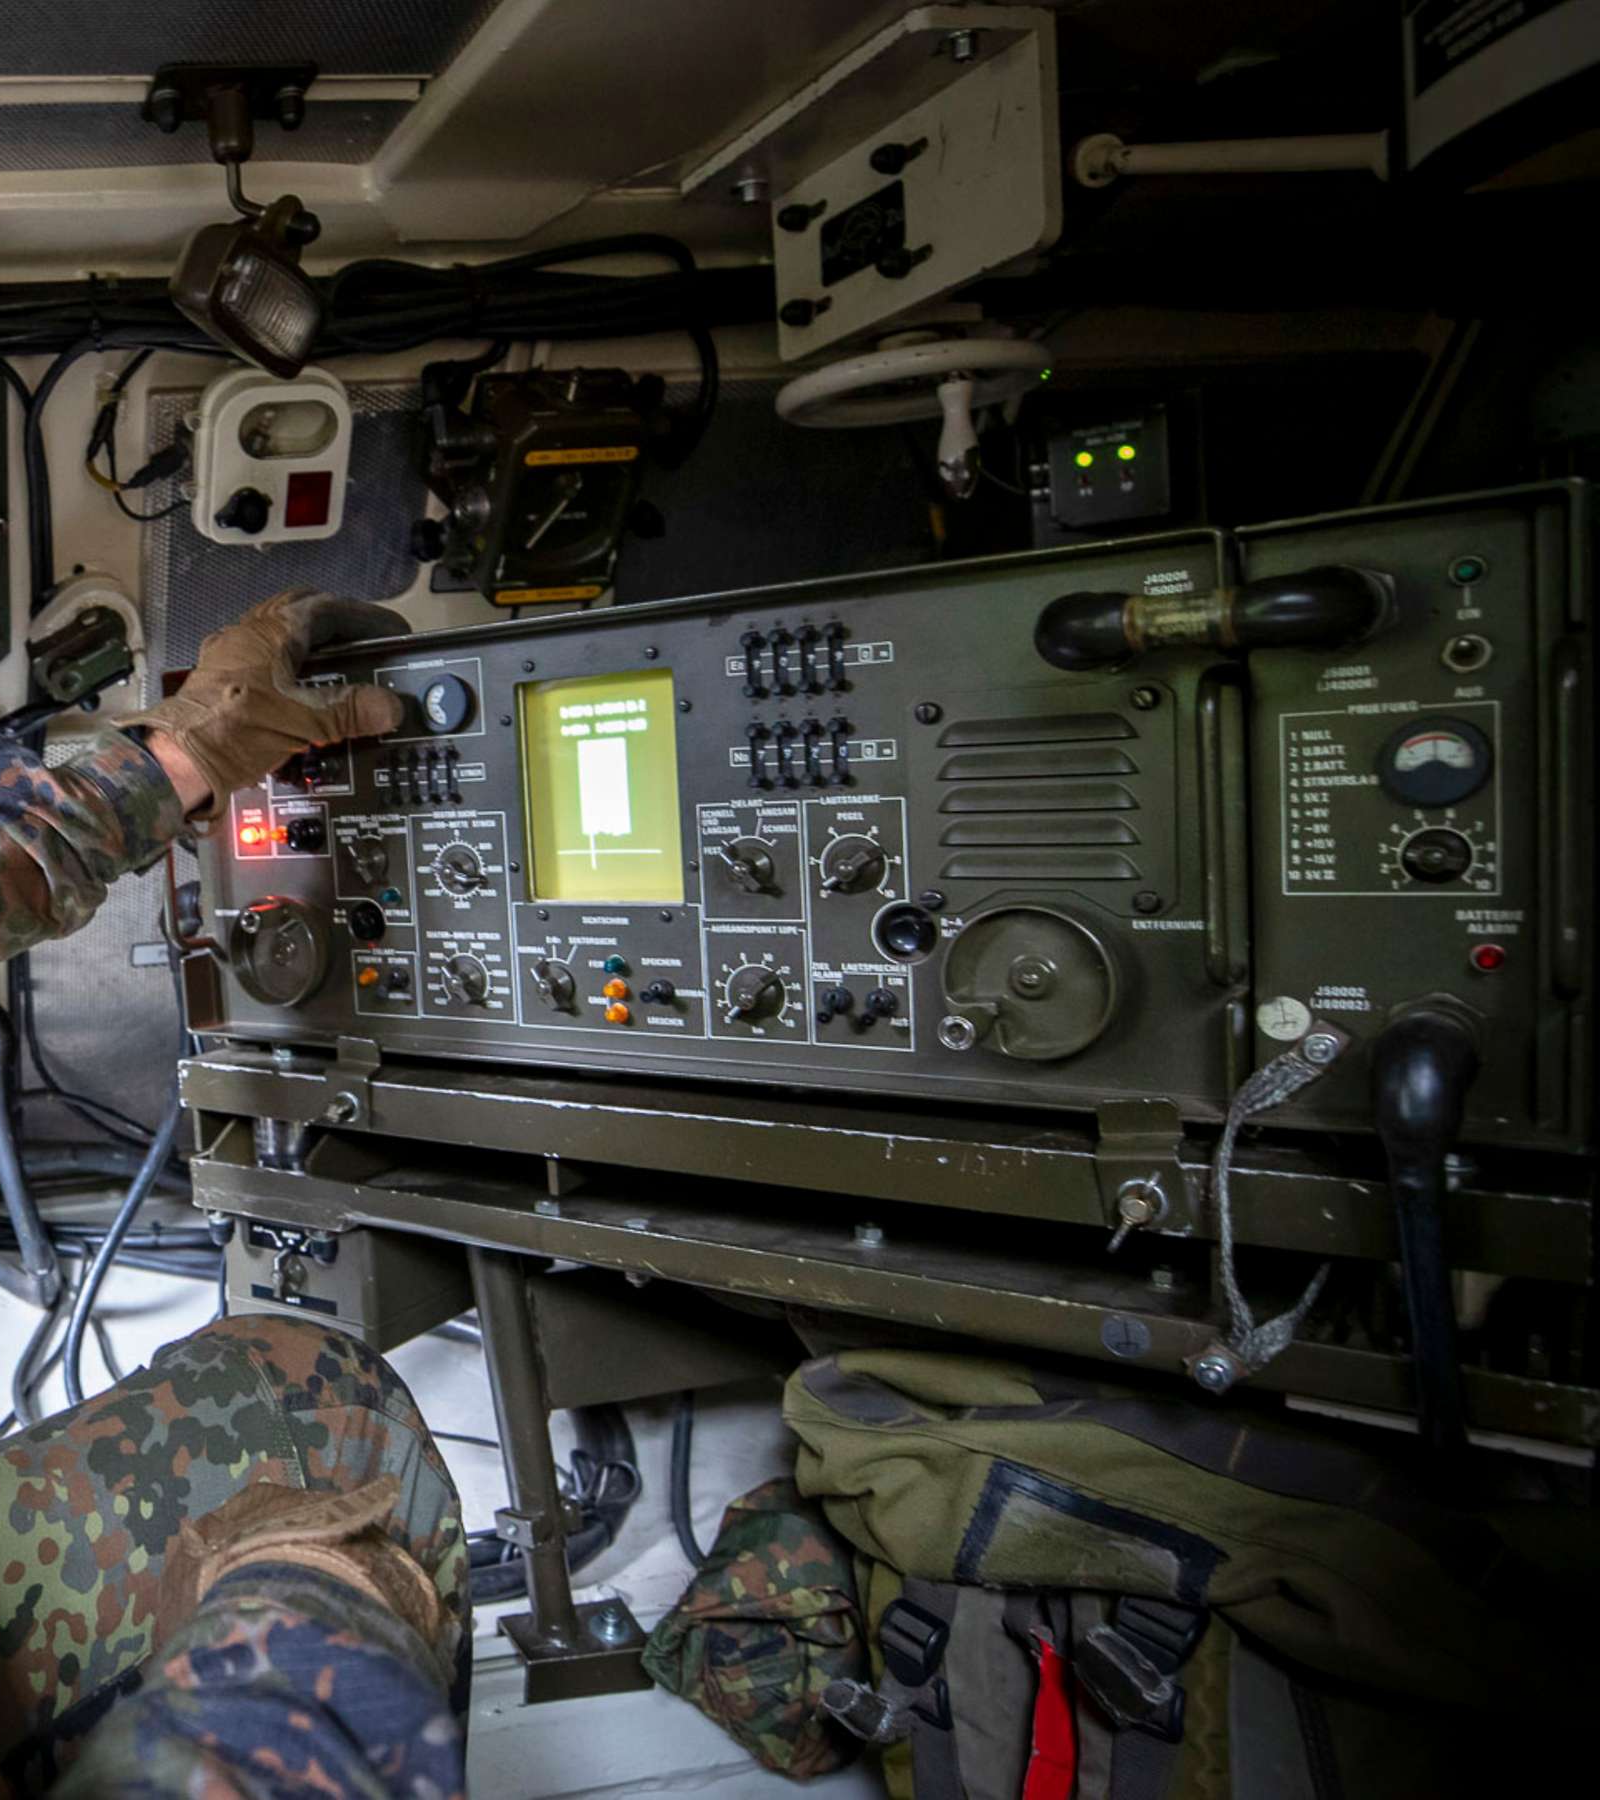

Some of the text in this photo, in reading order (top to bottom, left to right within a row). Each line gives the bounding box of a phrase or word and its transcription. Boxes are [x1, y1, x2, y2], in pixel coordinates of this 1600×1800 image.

[1456, 909, 1523, 921] BATTERIE
[1132, 919, 1205, 931] ENTFERNUNG
[1467, 923, 1518, 935] ALARM
